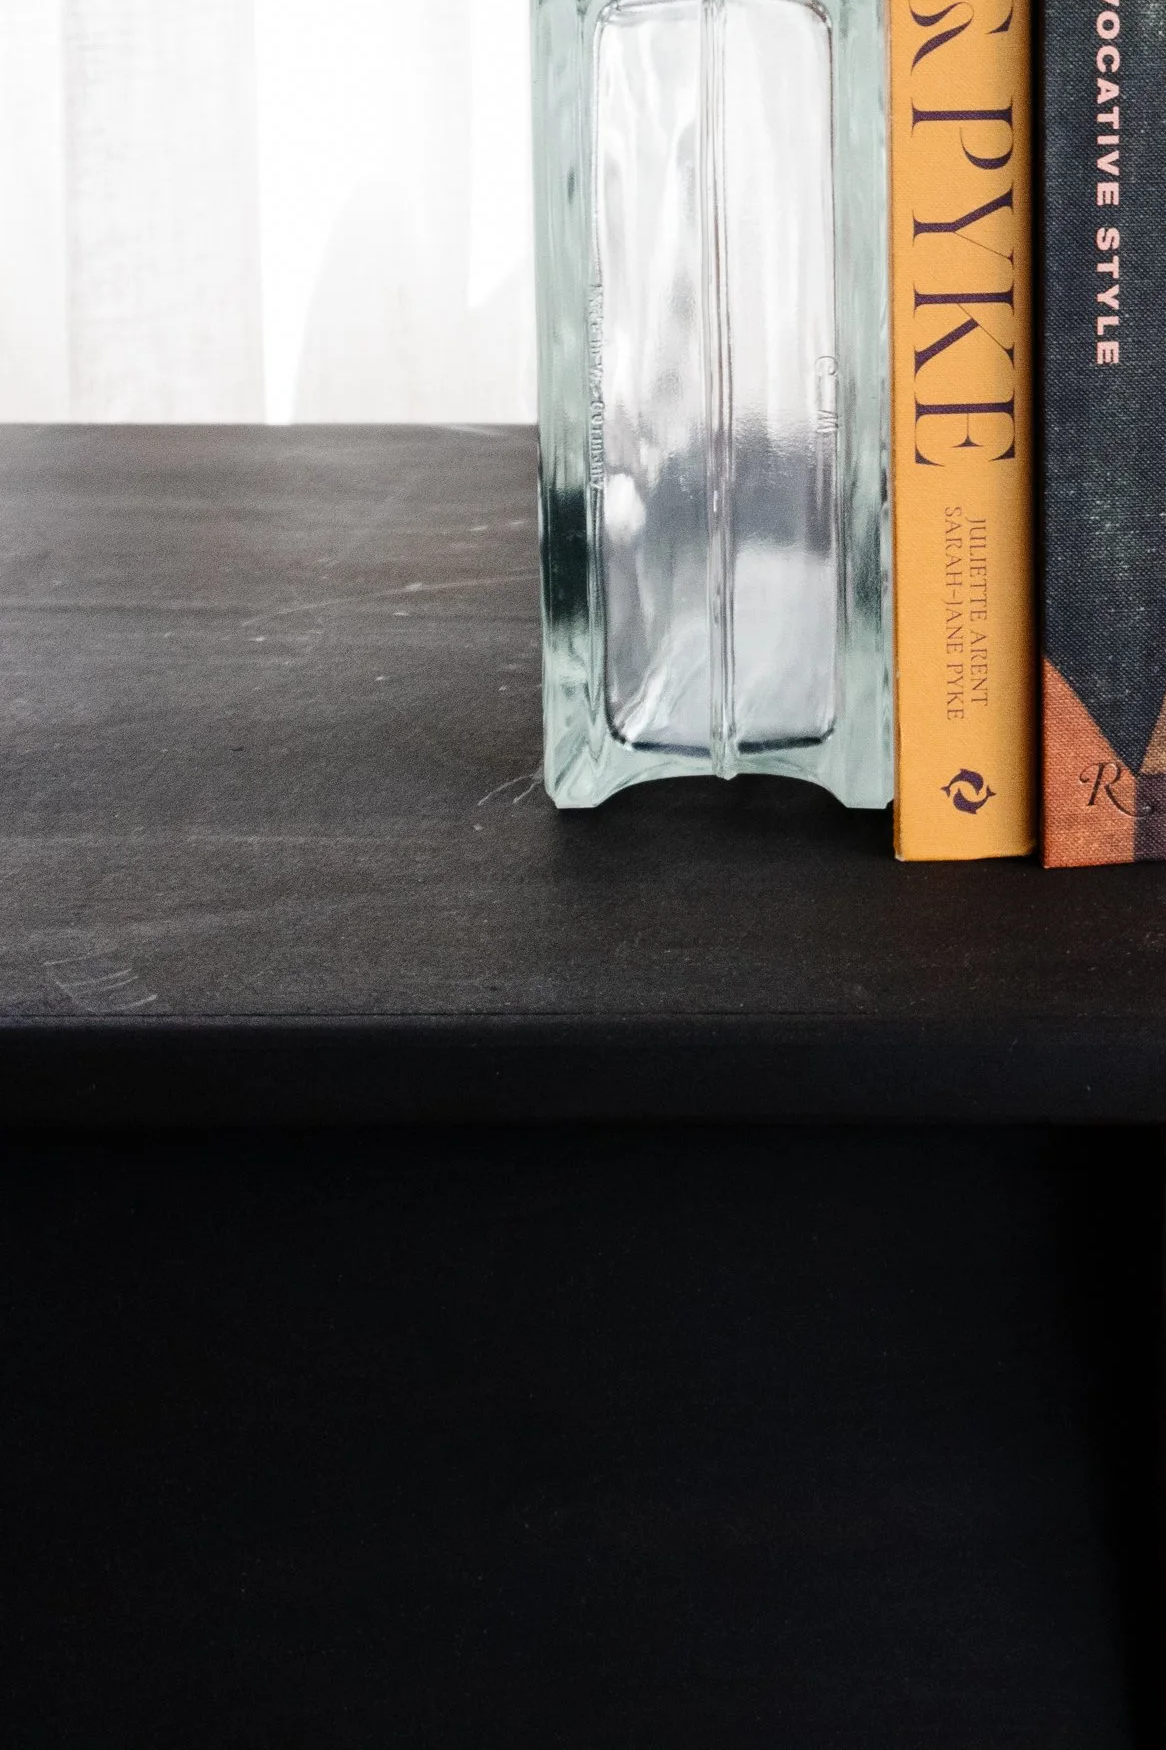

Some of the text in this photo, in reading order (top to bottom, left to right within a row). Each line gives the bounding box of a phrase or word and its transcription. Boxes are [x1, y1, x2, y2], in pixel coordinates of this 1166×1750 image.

[911, 97, 1017, 468] PYKE
[1095, 227, 1120, 366] STYLE
[944, 506, 965, 720] SARAH-JANE PYKE
[967, 517, 988, 707] JULIETTE ARENT
